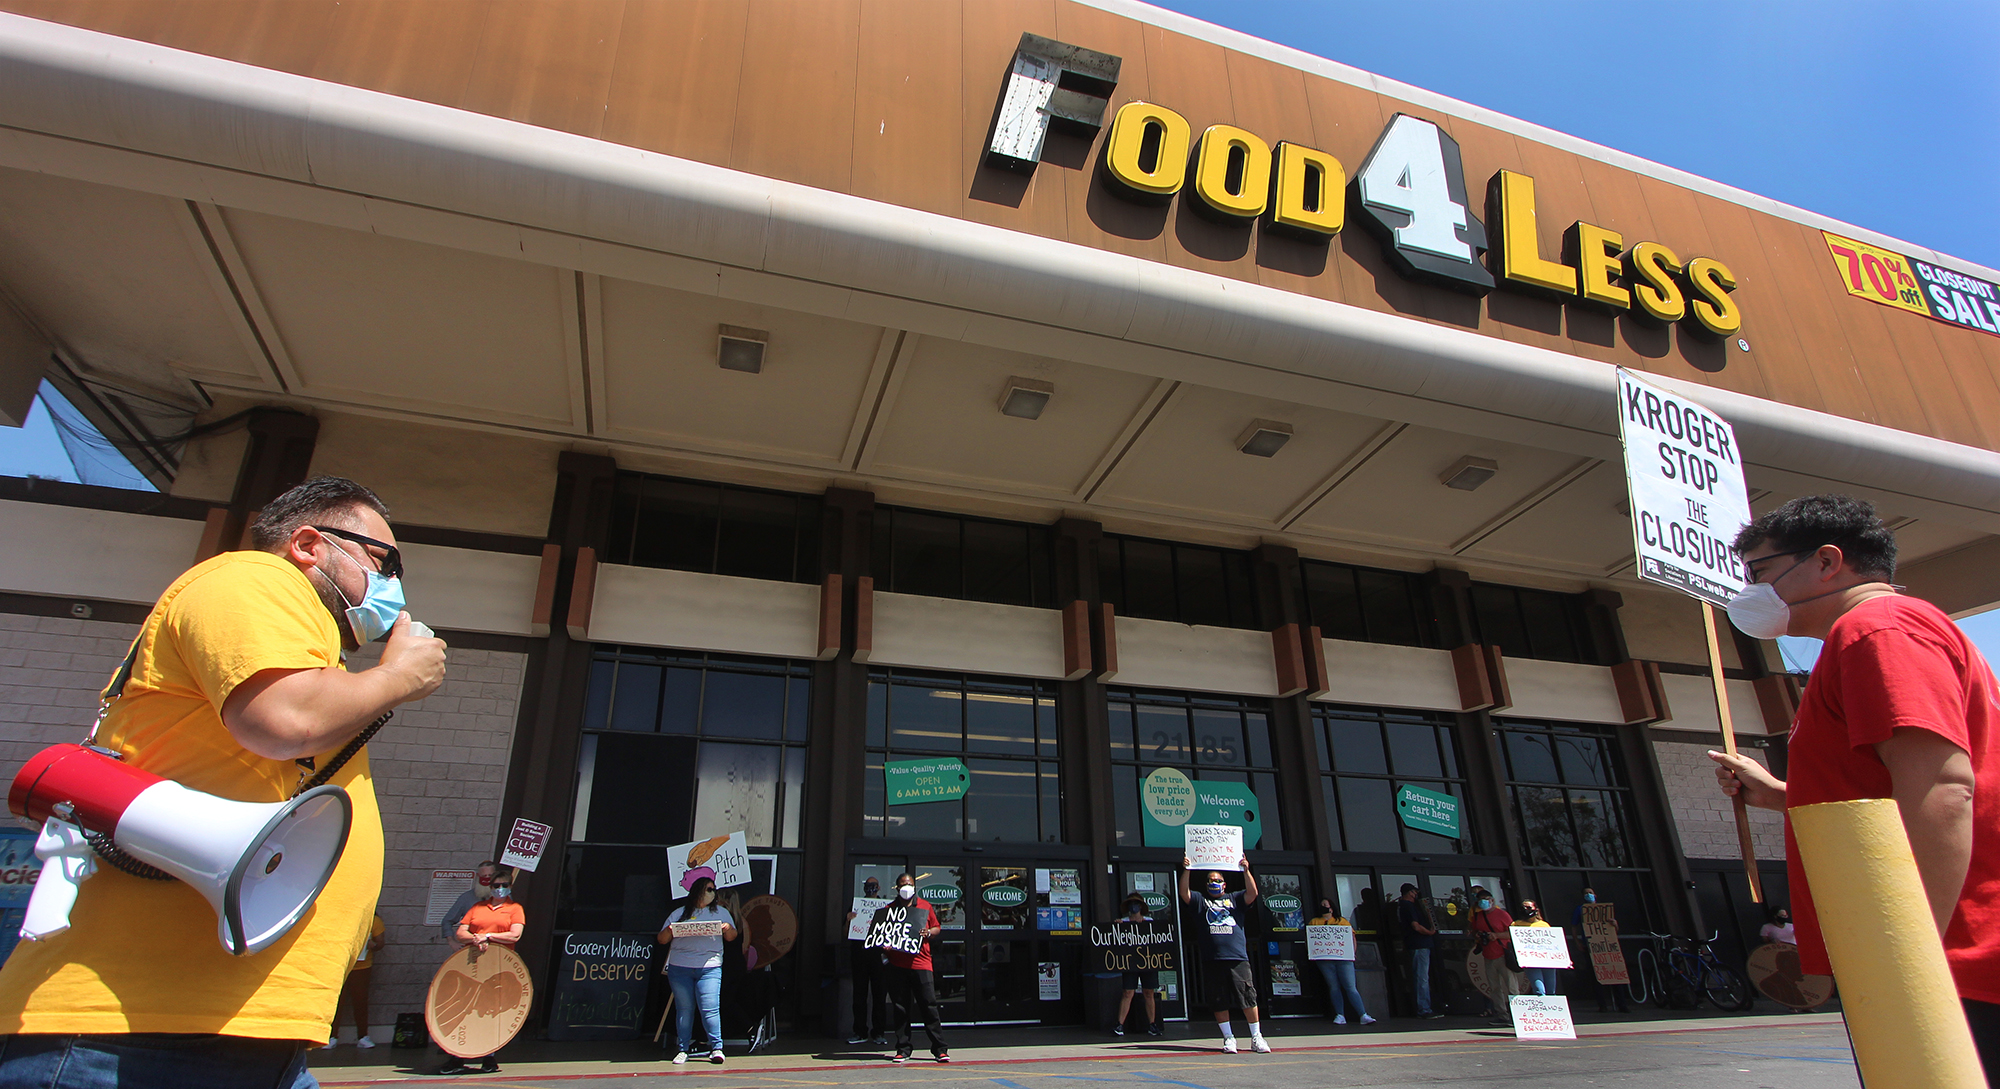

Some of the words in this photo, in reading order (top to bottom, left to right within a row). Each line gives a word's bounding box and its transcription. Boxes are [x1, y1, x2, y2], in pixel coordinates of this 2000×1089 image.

[1352, 112, 1485, 280] 4
[1489, 168, 1741, 338] LESS
[1830, 244, 1916, 301] 70%
[1900, 288, 1922, 307] off
[1916, 262, 1996, 300] CLOSEOUT
[1625, 381, 1735, 465] KROGER
[1658, 442, 1718, 495] STOP
[1684, 497, 1709, 525] THE
[1641, 510, 1744, 582] CLOSURE
[1688, 572, 1738, 601] PSLweb.or
[915, 776, 940, 786] OPEN
[1154, 775, 1167, 783] The
[1169, 776, 1183, 784] true
[896, 789, 903, 798] 6
[905, 788, 920, 797] AM
[934, 786, 944, 794] 12
[947, 785, 961, 793] AM
[1148, 784, 1164, 794] low
[1167, 785, 1190, 796] price
[1156, 796, 1185, 806] leader
[1200, 794, 1245, 806] Welcome
[1405, 790, 1435, 806] Return
[1436, 800, 1455, 811] your
[1154, 808, 1172, 817] every
[1175, 808, 1189, 817] day!
[1219, 809, 1230, 819] to
[1411, 805, 1430, 816] cart
[1431, 808, 1450, 821] here
[510, 838, 540, 852] CLUE
[715, 848, 745, 872] Pitch
[0, 865, 41, 885] cie
[722, 871, 737, 885] In
[922, 889, 957, 899] WELCOME
[988, 891, 1021, 901] WELCOME
[1143, 897, 1165, 905] LCOME
[1268, 899, 1298, 908] WELCOME
[886, 906, 908, 922] NO
[872, 921, 912, 938] MORE
[1091, 925, 1112, 947] Our
[1515, 929, 1556, 938] ESSENTIAL
[1586, 922, 1609, 936] THE
[565, 933, 610, 958] Grocery
[610, 937, 653, 959] Workers
[503, 954, 513, 963] IN
[1105, 949, 1132, 970] Our
[1136, 946, 1173, 970] Store
[1593, 953, 1608, 965] NOT
[1610, 952, 1623, 963] THE
[512, 962, 525, 980] GOD
[573, 959, 645, 981] Deserve
[1469, 961, 1481, 982] ONE
[1480, 982, 1493, 994] CE
[522, 983, 529, 997] WE
[507, 1003, 527, 1034] TRUST
[614, 990, 645, 1031] Pay
[457, 1025, 467, 1046] 2020
